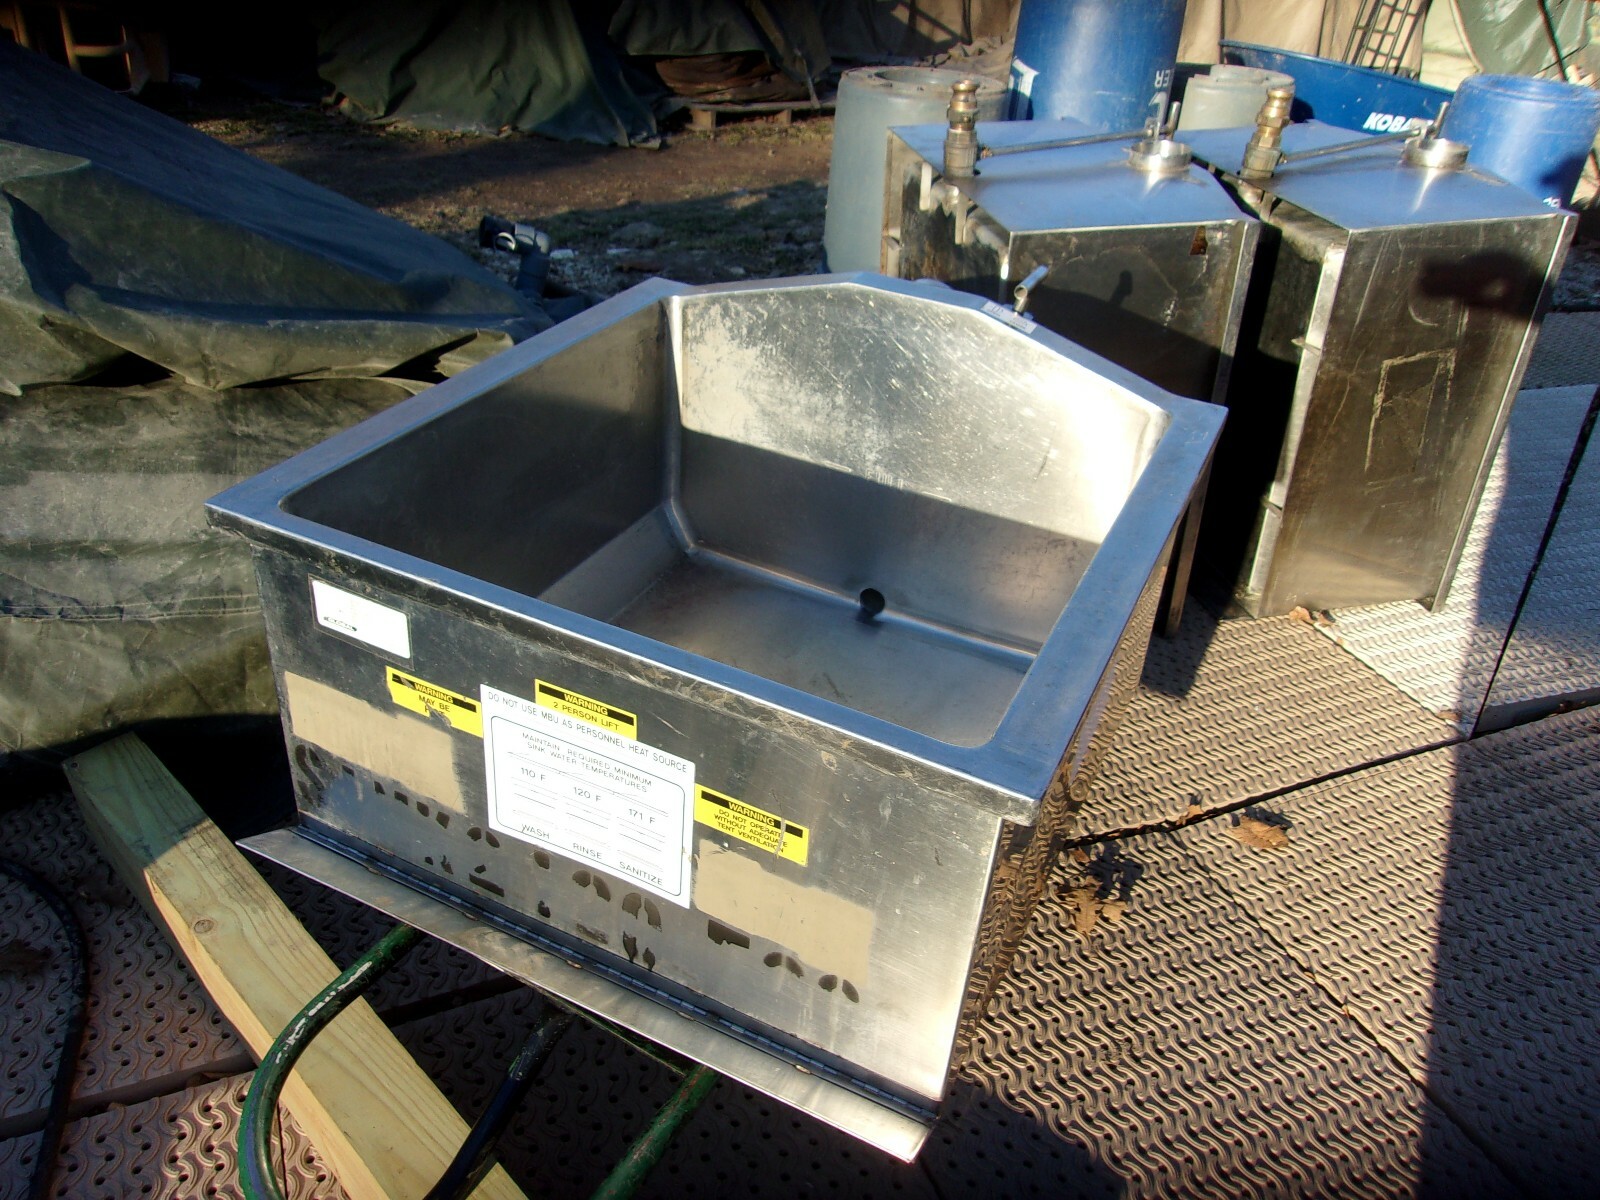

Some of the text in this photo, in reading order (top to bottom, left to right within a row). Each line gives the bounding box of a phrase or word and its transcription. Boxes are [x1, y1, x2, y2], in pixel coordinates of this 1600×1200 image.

[414, 682, 453, 703] WARNING
[439, 703, 450, 712] BE
[563, 693, 608, 715] WARNING
[562, 704, 598, 722] PERSON
[601, 720, 619, 731] LIFT
[488, 692, 687, 773] DO NOT USE MBU AS PERSONNEL HEAT SOURCE
[522, 732, 652, 786] MAINTAIN REQUIRED MINIMUM
[528, 742, 647, 792] SINK WATER TEMPERATURES
[521, 767, 536, 778] 110
[573, 786, 601, 802] 120 F
[628, 808, 656, 824] 171 F
[719, 808, 730, 818] DO
[732, 814, 748, 825] NOT
[728, 801, 774, 826] WARNING
[521, 824, 550, 839] WASH
[714, 814, 788, 848] WITHOUT ADEQUAE
[718, 822, 735, 833] TENT
[572, 842, 602, 860] RINSE
[620, 861, 663, 886] SANITIZE
